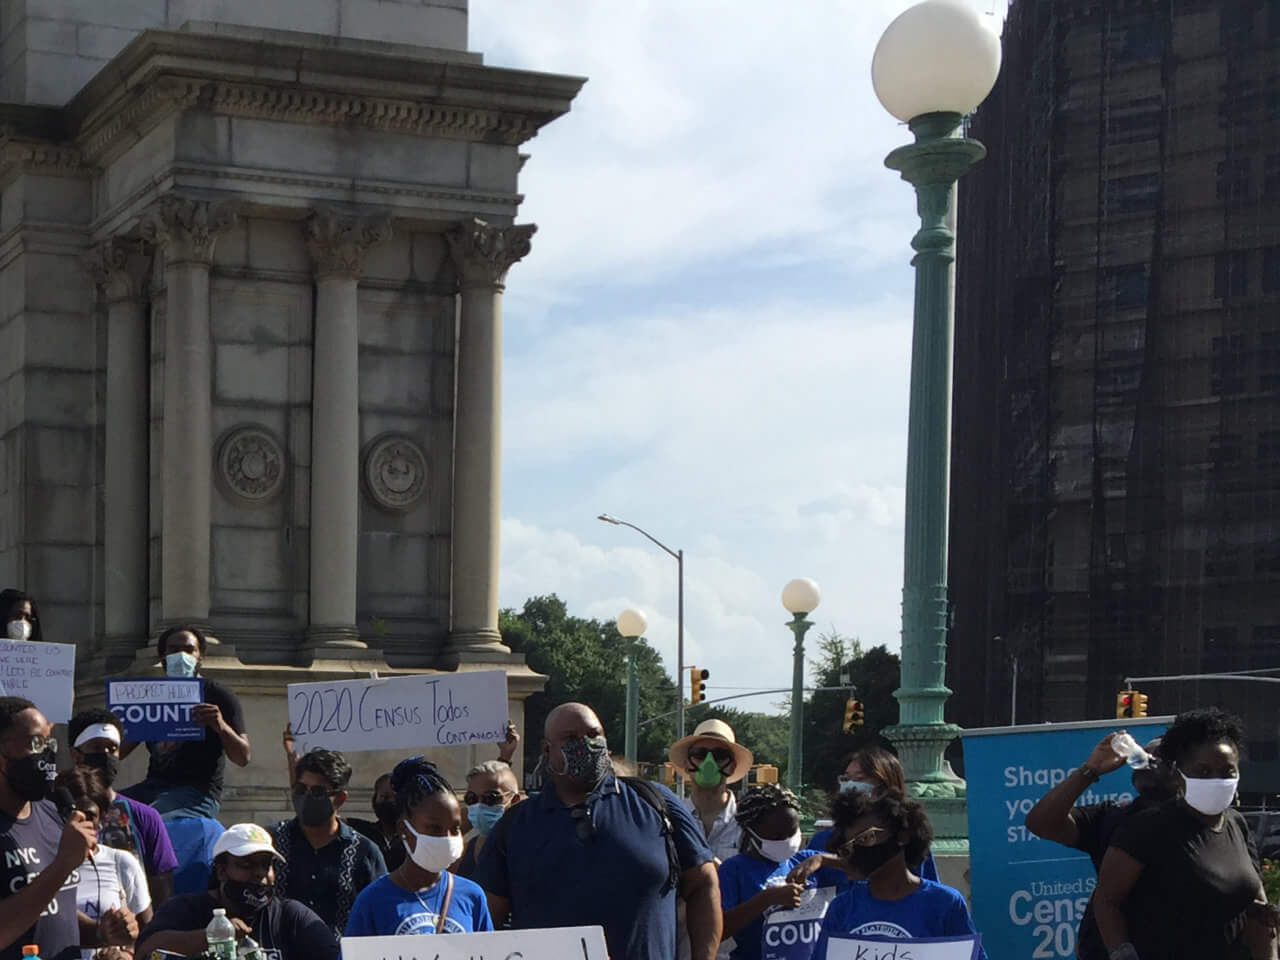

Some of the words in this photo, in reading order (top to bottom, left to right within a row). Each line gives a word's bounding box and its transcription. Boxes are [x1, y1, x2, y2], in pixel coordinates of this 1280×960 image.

[294, 687, 352, 735] 2020
[1007, 825, 1041, 843] STA
[5, 847, 40, 868] NYC
[1031, 880, 1083, 897] United
[1009, 889, 1091, 926] Cens
[765, 921, 822, 947] COUN
[1032, 922, 1077, 960] 20
